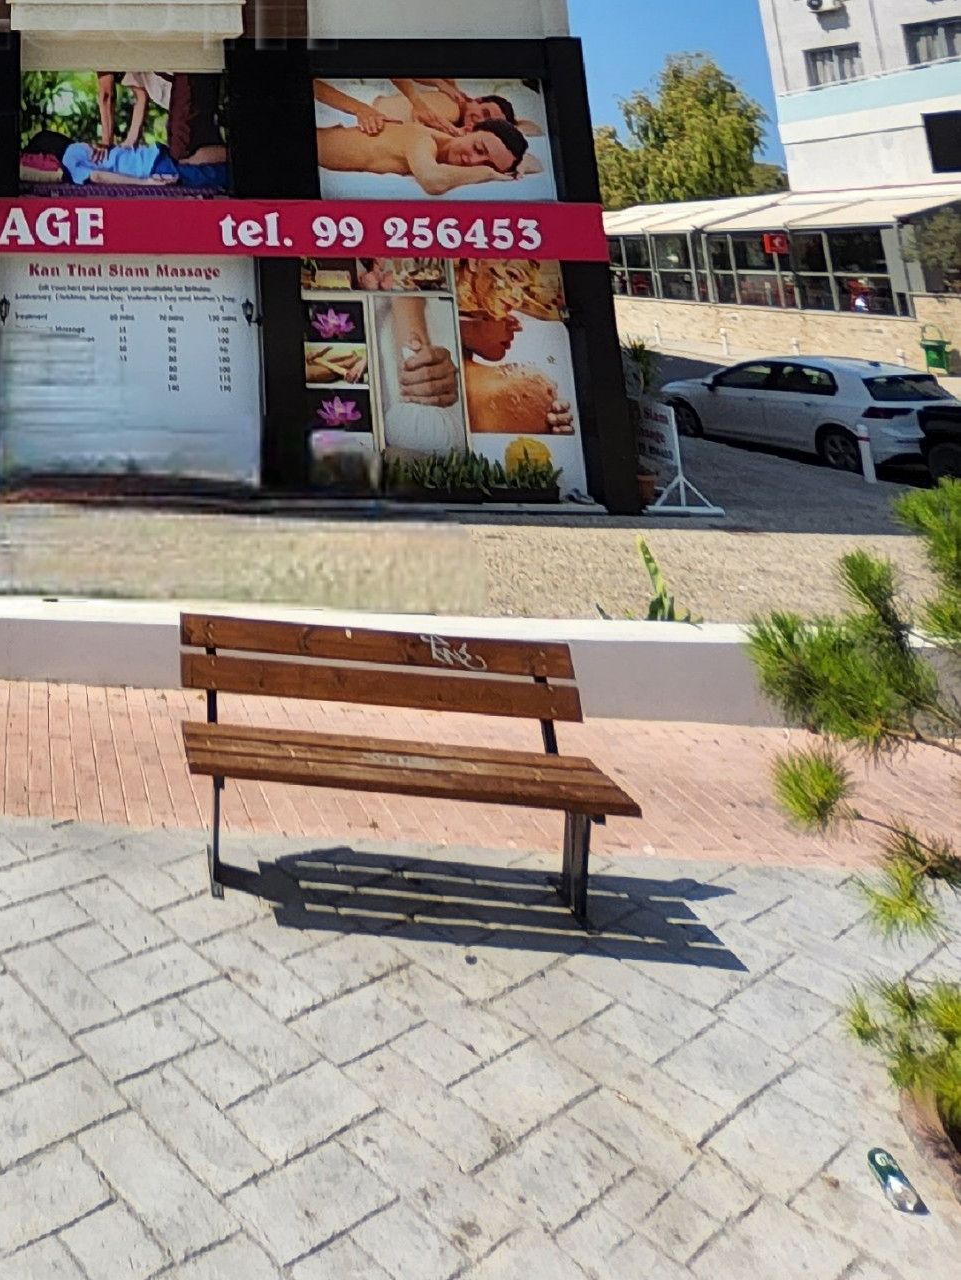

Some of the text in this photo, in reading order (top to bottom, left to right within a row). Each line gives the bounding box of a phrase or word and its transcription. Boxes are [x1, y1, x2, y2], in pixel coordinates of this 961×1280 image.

[219, 212, 293, 248] tel.
[312, 216, 365, 248] 99
[383, 216, 542, 250] 256453
[29, 263, 221, 280] Kan Thai Siam Massage
